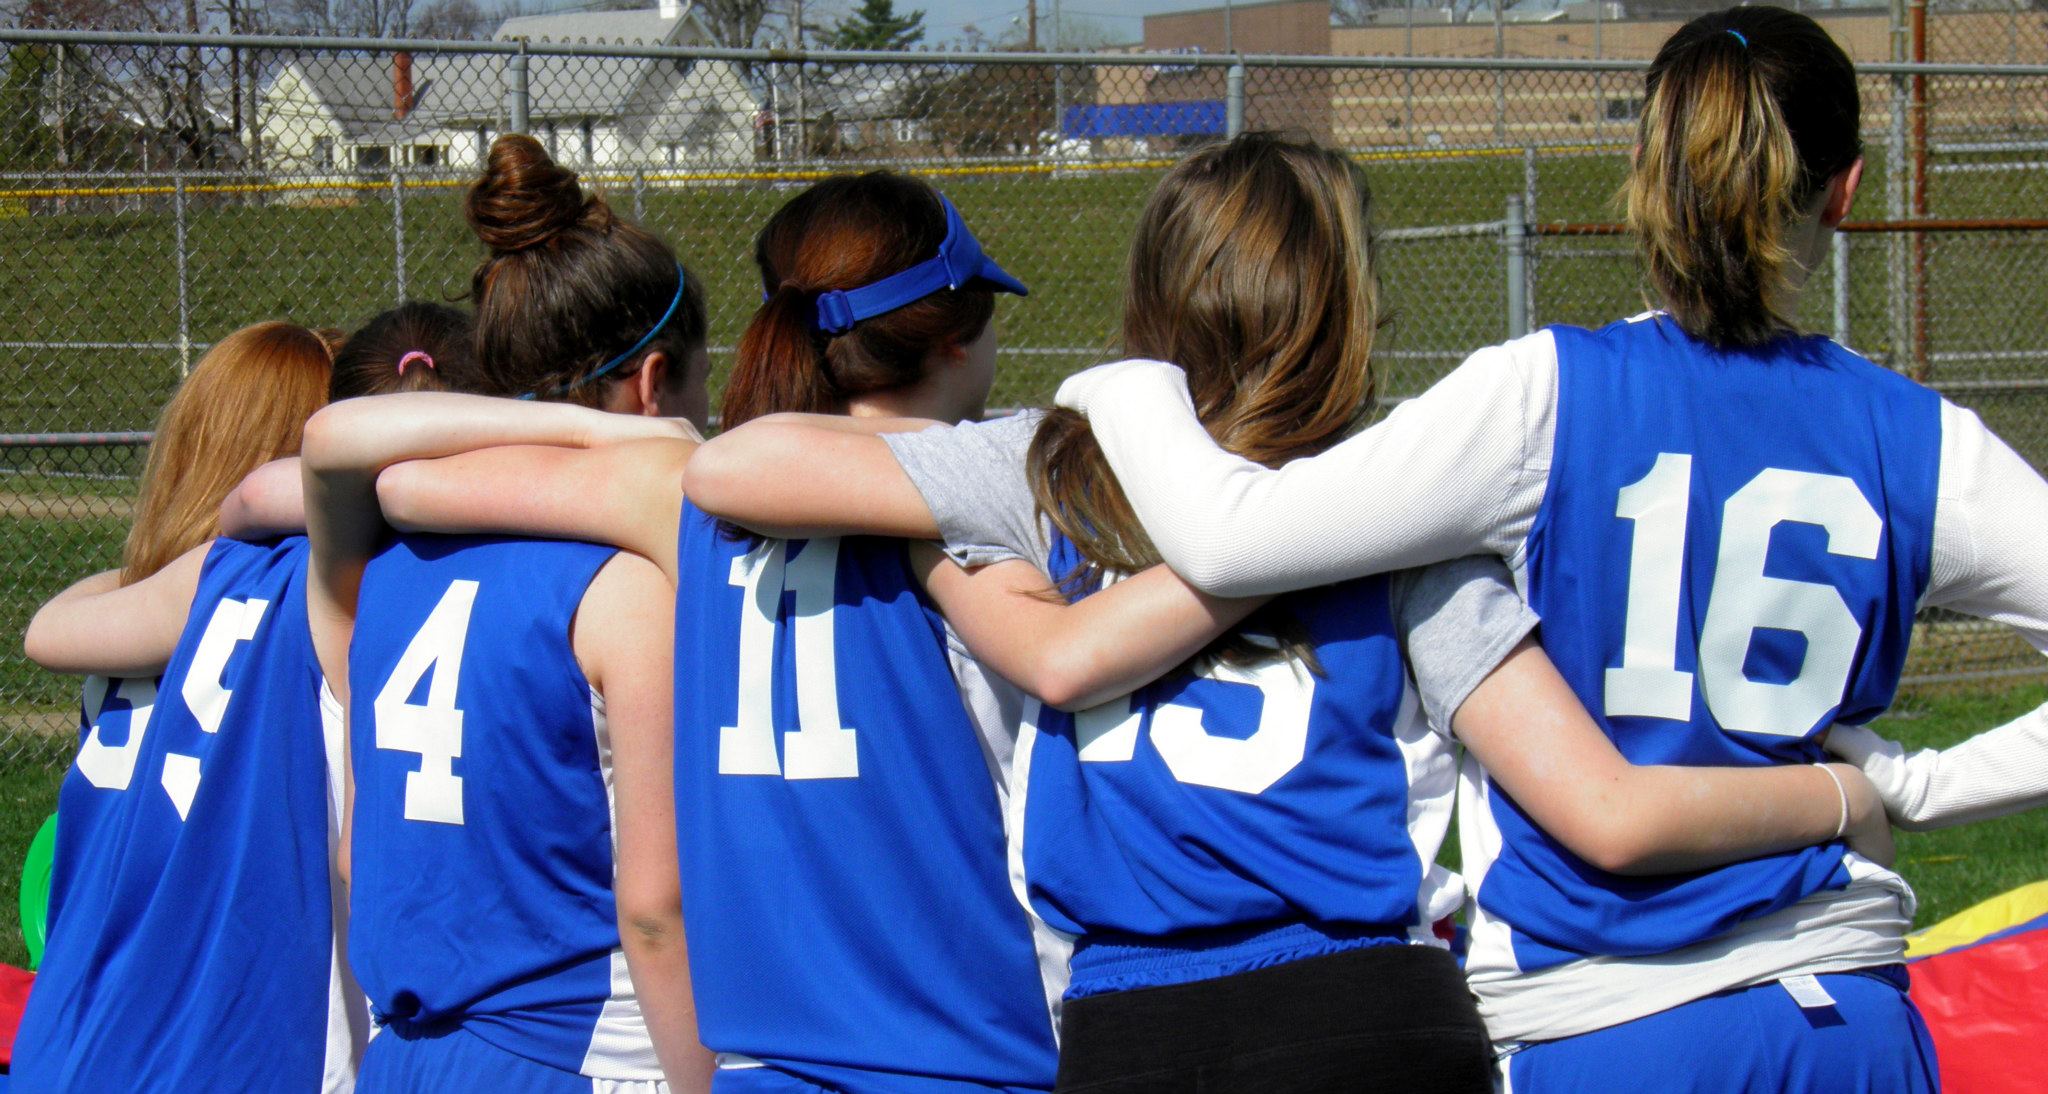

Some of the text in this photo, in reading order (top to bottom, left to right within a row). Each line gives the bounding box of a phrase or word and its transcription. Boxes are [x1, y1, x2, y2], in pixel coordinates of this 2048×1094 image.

[374, 580, 480, 825] 4
[718, 538, 859, 780] 11
[1605, 452, 1883, 738] 16
